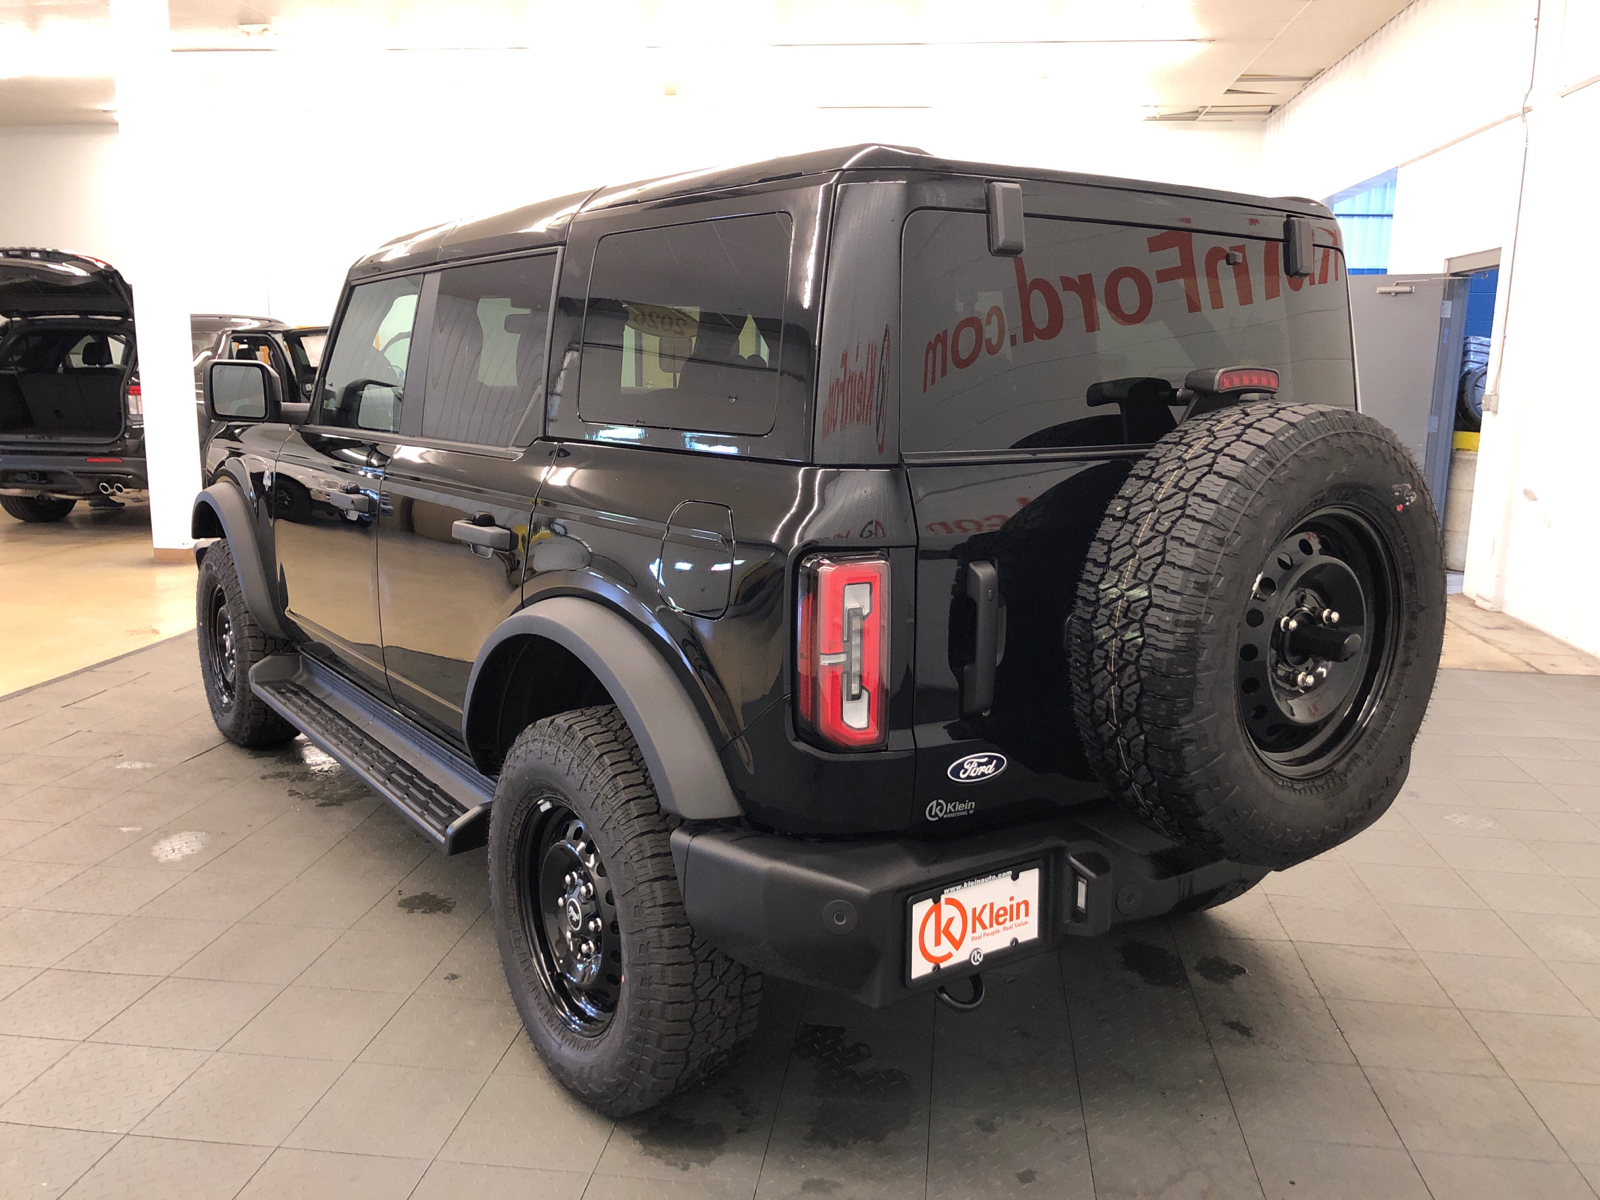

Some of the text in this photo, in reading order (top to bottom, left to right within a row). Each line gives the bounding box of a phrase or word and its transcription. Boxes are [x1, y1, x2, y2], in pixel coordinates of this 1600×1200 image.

[959, 757, 997, 779] Ford
[947, 800, 976, 813] Klein
[943, 870, 1013, 894] www.kleinauto.com
[971, 896, 1030, 934] Klein
[971, 934, 982, 942] Real
[983, 929, 1001, 938] People.
[1002, 923, 1014, 932] Real
